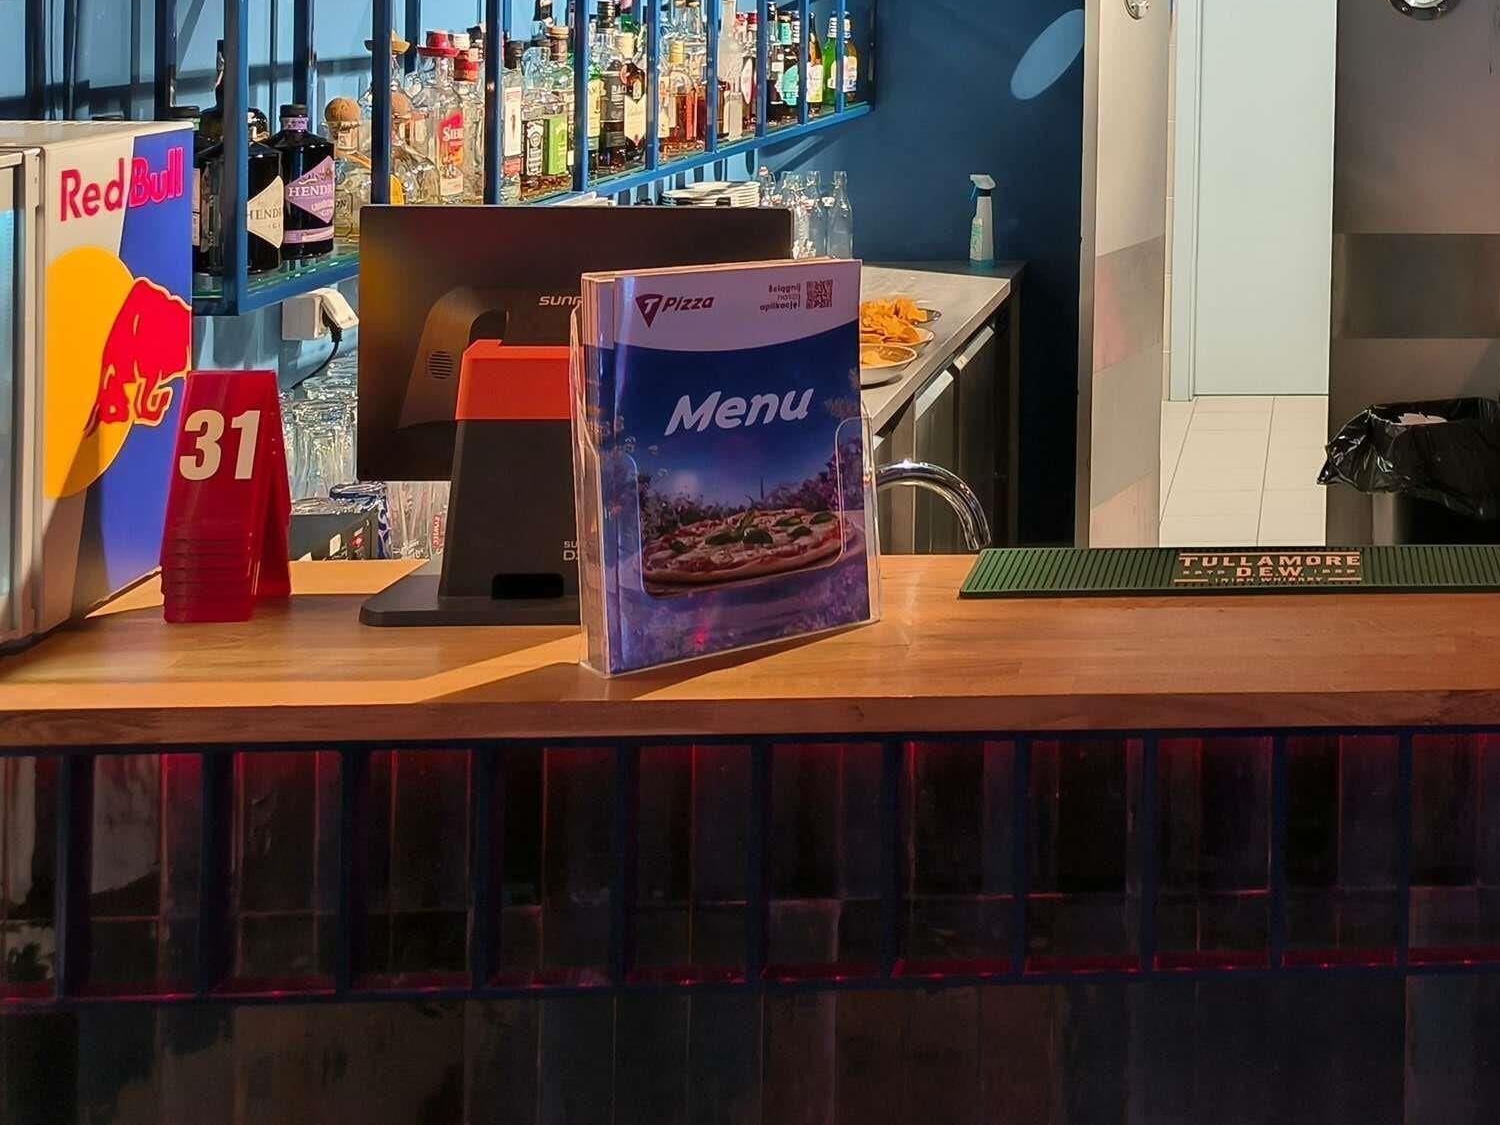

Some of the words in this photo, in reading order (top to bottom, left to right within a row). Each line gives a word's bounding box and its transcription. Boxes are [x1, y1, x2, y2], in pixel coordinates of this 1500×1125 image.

[60, 157, 125, 221] Red
[129, 147, 184, 208] Bull
[661, 296, 715, 312] Pizza
[664, 388, 815, 436] Menu
[179, 409, 261, 481] 31
[1179, 556, 1360, 567] TULLAMORE
